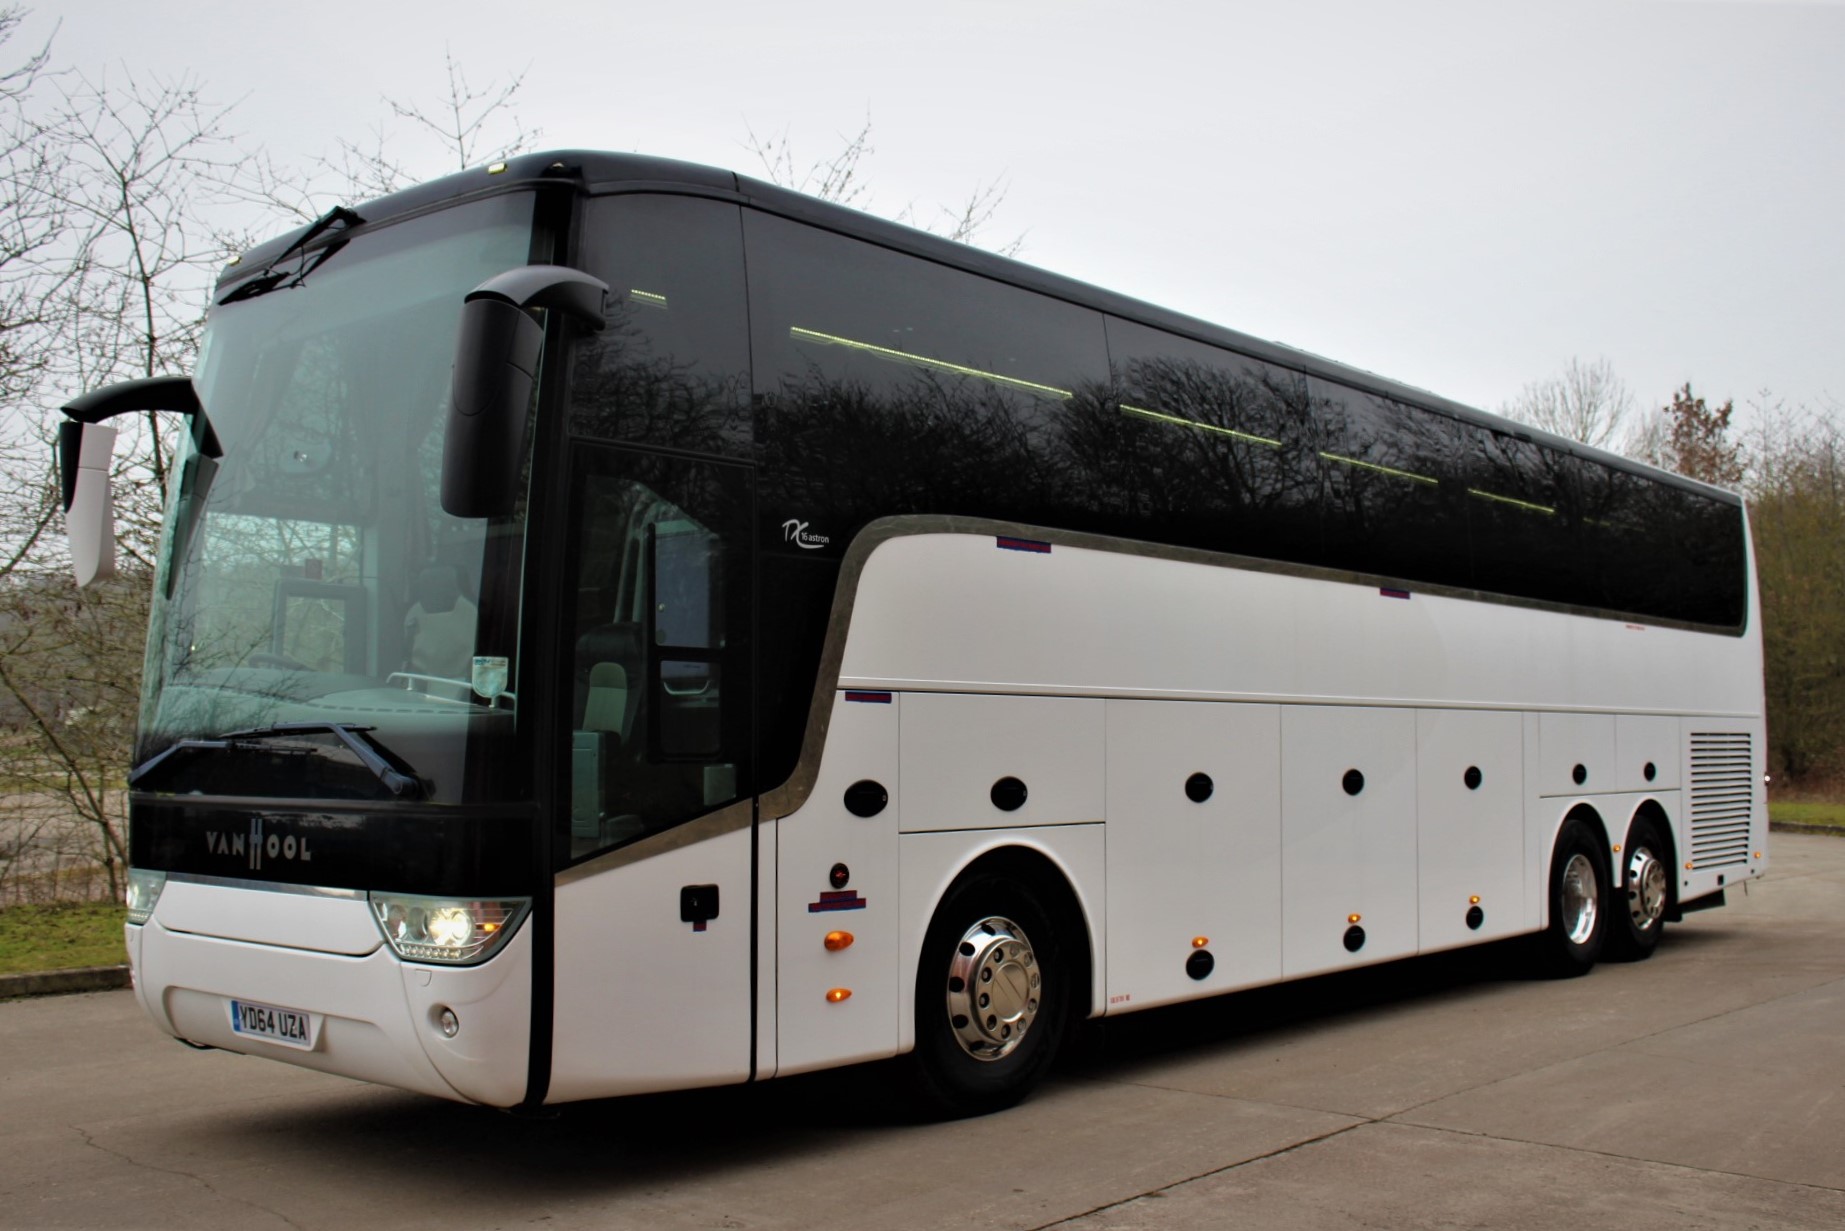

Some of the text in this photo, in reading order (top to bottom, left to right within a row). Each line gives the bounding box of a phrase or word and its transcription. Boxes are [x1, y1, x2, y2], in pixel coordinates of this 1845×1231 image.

[808, 534, 830, 544] astron
[206, 818, 311, 870] VAN HOOL
[240, 1005, 307, 1041] YD64 UZA
